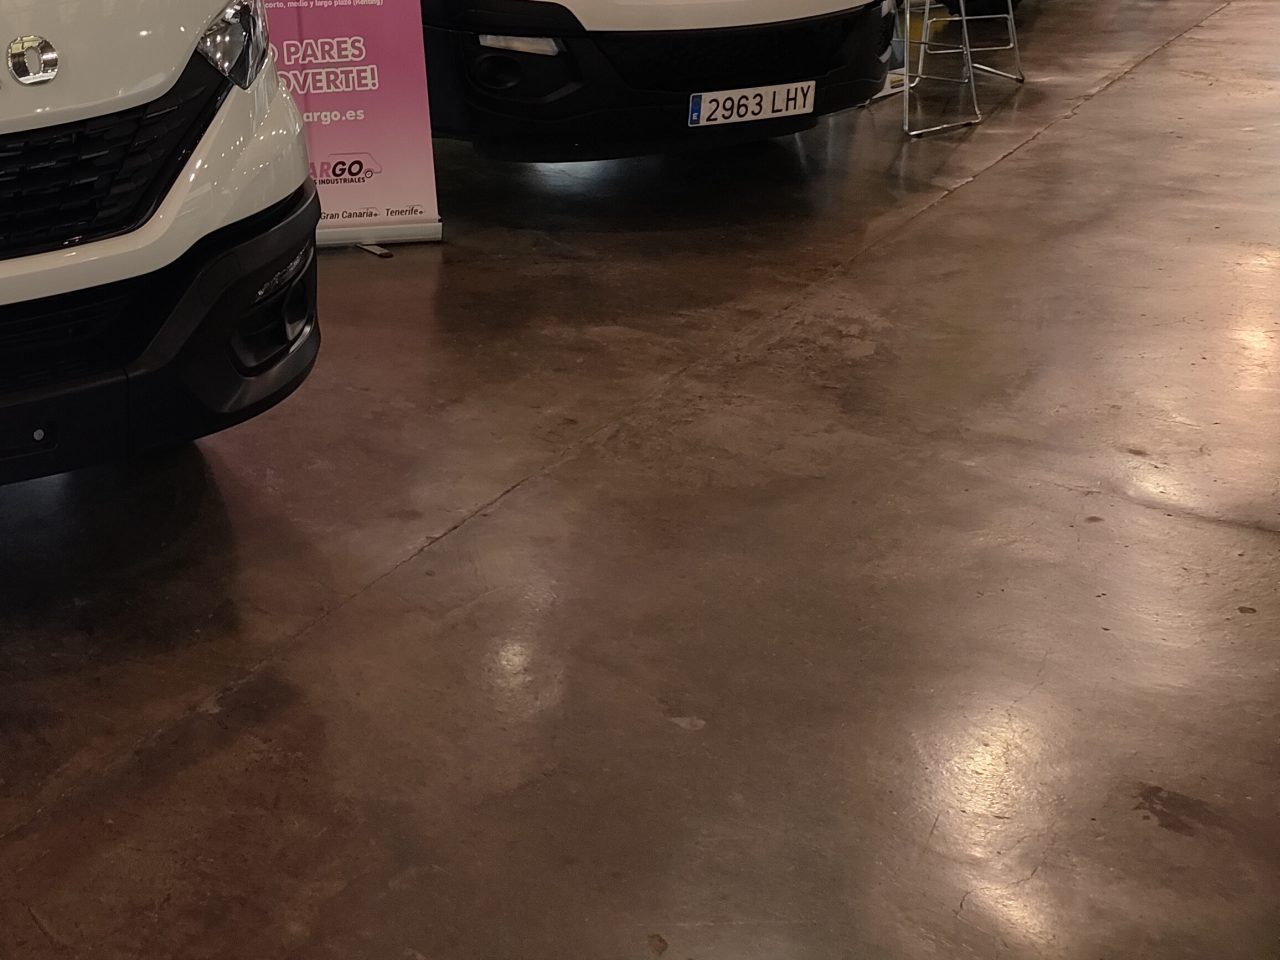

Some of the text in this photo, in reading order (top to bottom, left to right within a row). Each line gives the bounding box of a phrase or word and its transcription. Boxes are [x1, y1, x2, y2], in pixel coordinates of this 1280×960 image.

[265, 0, 286, 9] corto,
[287, 0, 308, 7] medio
[309, 0, 314, 8] y
[315, 0, 332, 8] largo
[283, 36, 366, 65] PARES
[277, 65, 379, 94] OVERTE!
[705, 84, 811, 122] 2963 LHY
[303, 109, 365, 125] argo.es
[309, 160, 364, 178] ARGO
[319, 176, 366, 185] INDUSTRIALES
[320, 206, 419, 220] Gran Canaria Tenerife
